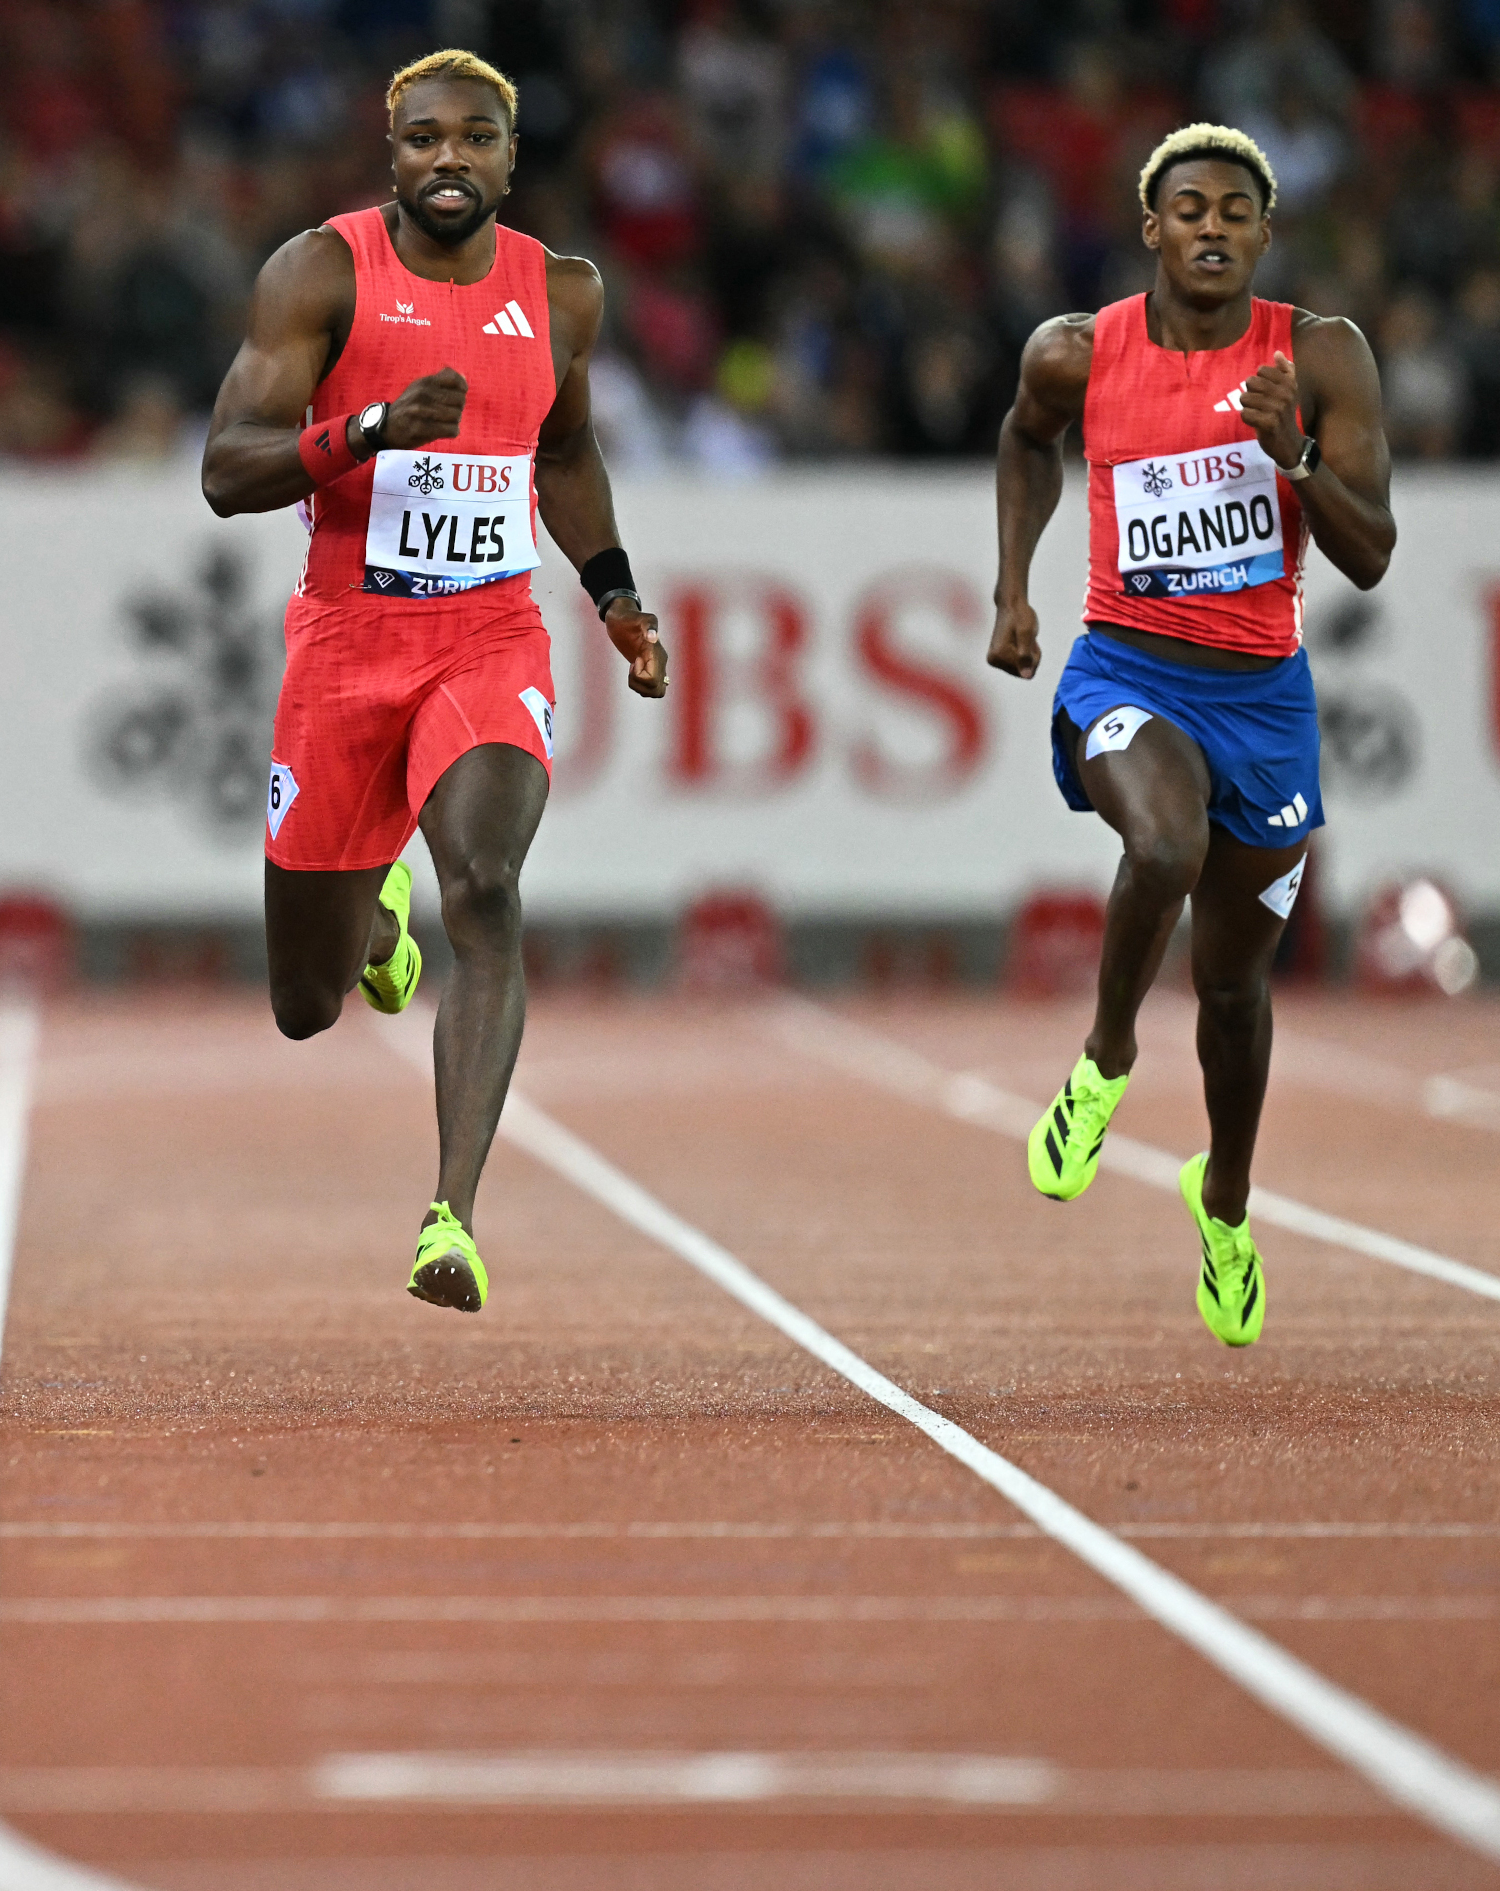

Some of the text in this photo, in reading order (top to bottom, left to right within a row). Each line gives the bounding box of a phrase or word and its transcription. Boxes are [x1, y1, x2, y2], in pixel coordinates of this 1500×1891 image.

[379, 313, 431, 326] Tirop's Angels
[451, 463, 512, 493] UBS
[1176, 451, 1245, 487] UBS
[398, 510, 506, 563] LYLES
[1127, 494, 1274, 562] OGANDO
[1166, 564, 1248, 592] ZURICH
[1103, 717, 1125, 739] 5
[270, 774, 281, 810] 6
